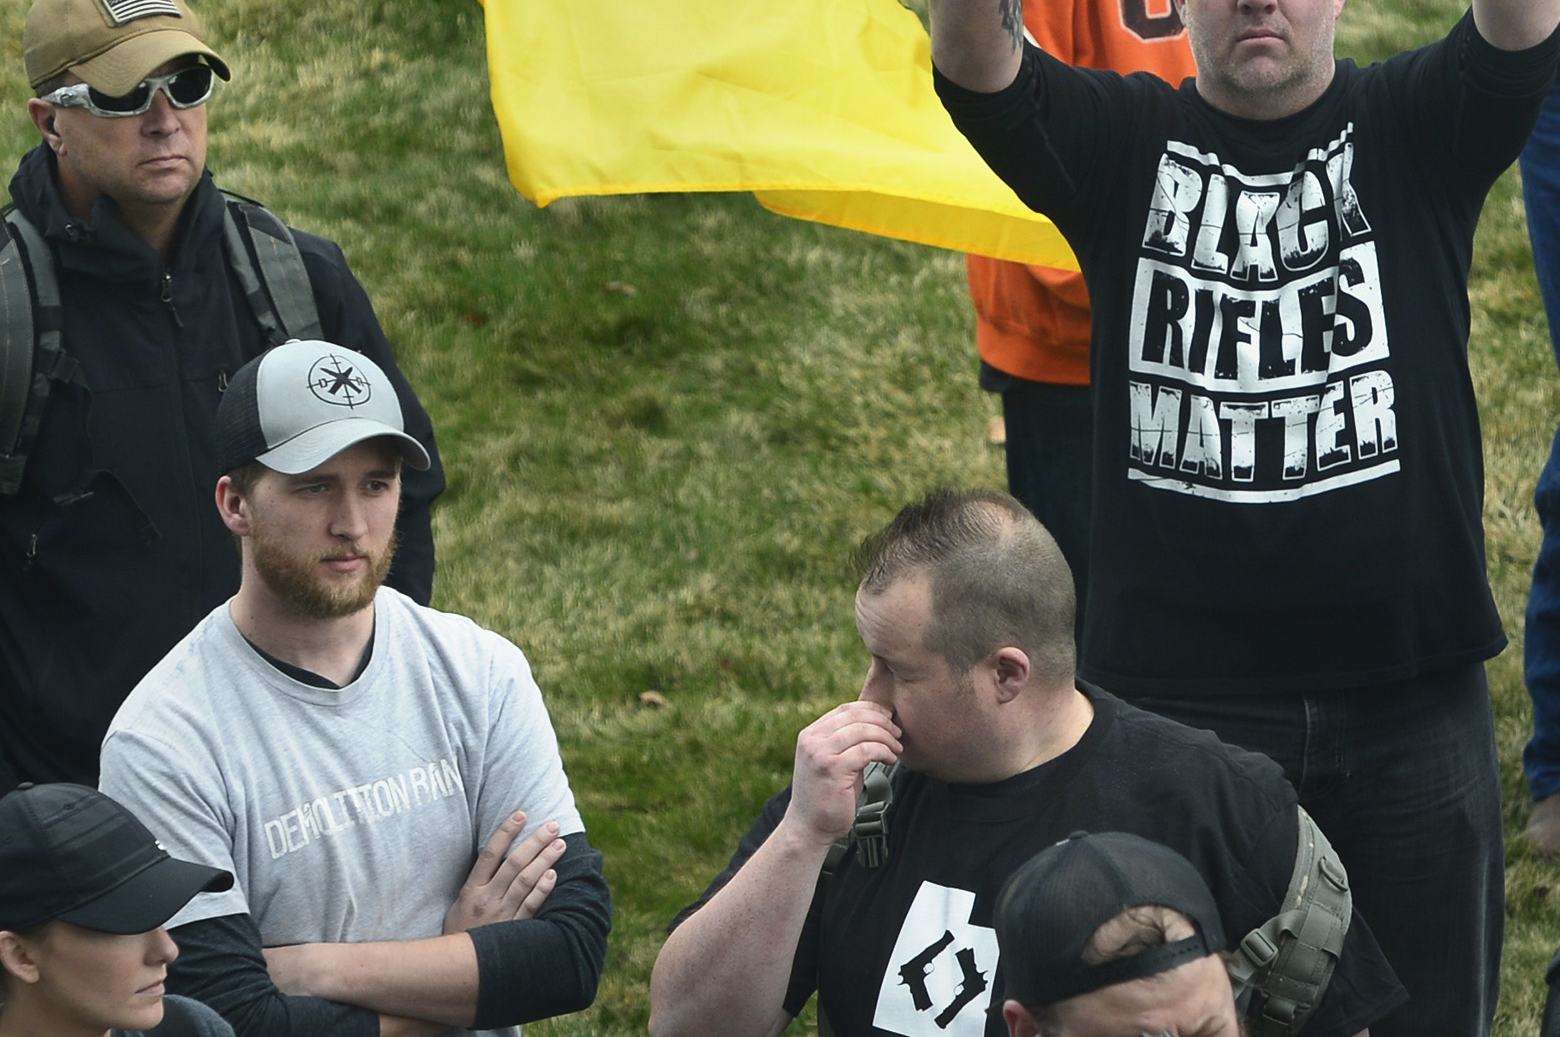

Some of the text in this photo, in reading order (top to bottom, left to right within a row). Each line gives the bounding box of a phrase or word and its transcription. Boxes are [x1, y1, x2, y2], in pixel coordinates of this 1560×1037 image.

[1142, 142, 1372, 282] BLACK
[1142, 257, 1373, 381] RIFLES
[1129, 370, 1398, 483] MATTER
[264, 772, 411, 860] DEMOLITION
